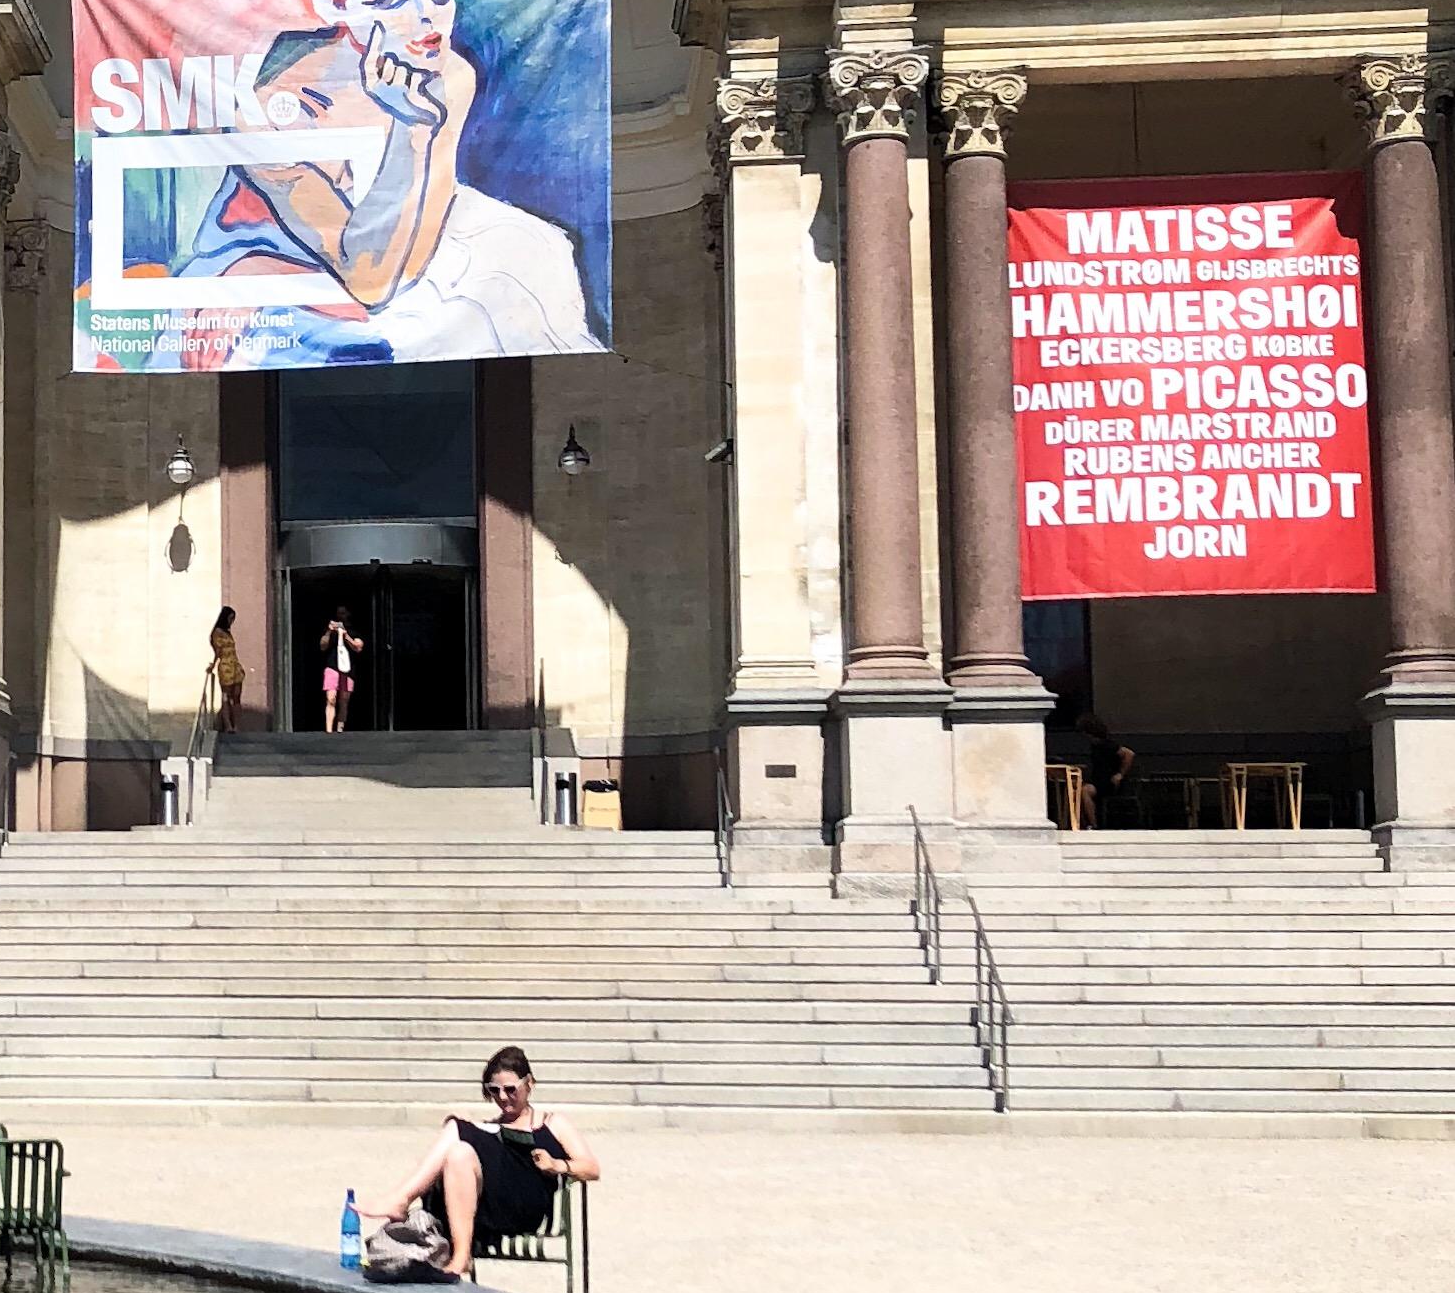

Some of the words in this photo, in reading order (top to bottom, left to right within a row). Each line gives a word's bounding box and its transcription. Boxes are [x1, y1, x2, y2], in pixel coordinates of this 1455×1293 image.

[1066, 205, 1295, 255] MATISSE
[1008, 258, 1191, 288] LUNDSTRØM
[1196, 255, 1359, 282] GIJSBRECHTS
[90, 314, 151, 331] Statens
[153, 313, 221, 330] Museum
[224, 313, 245, 328] for
[250, 312, 294, 328] Kunst
[1011, 284, 1358, 338] HAMMERSHØI
[90, 335, 154, 352] National
[158, 334, 211, 356] Gallery
[216, 333, 230, 350] of
[232, 332, 302, 350] Denmark
[1040, 334, 1246, 367] ECKERSBERG
[1252, 334, 1334, 359] KØBKE
[1014, 381, 1095, 412] DANH
[1099, 378, 1144, 407] VO
[1150, 363, 1368, 409] PICASSO
[1045, 414, 1135, 445] DÜRER
[1140, 411, 1337, 441] MARSTRAND
[1064, 444, 1195, 476] RUBENS
[1201, 442, 1320, 471] ANCHER
[1025, 473, 1362, 526] REMBRANDT
[1143, 525, 1247, 559] JORN
